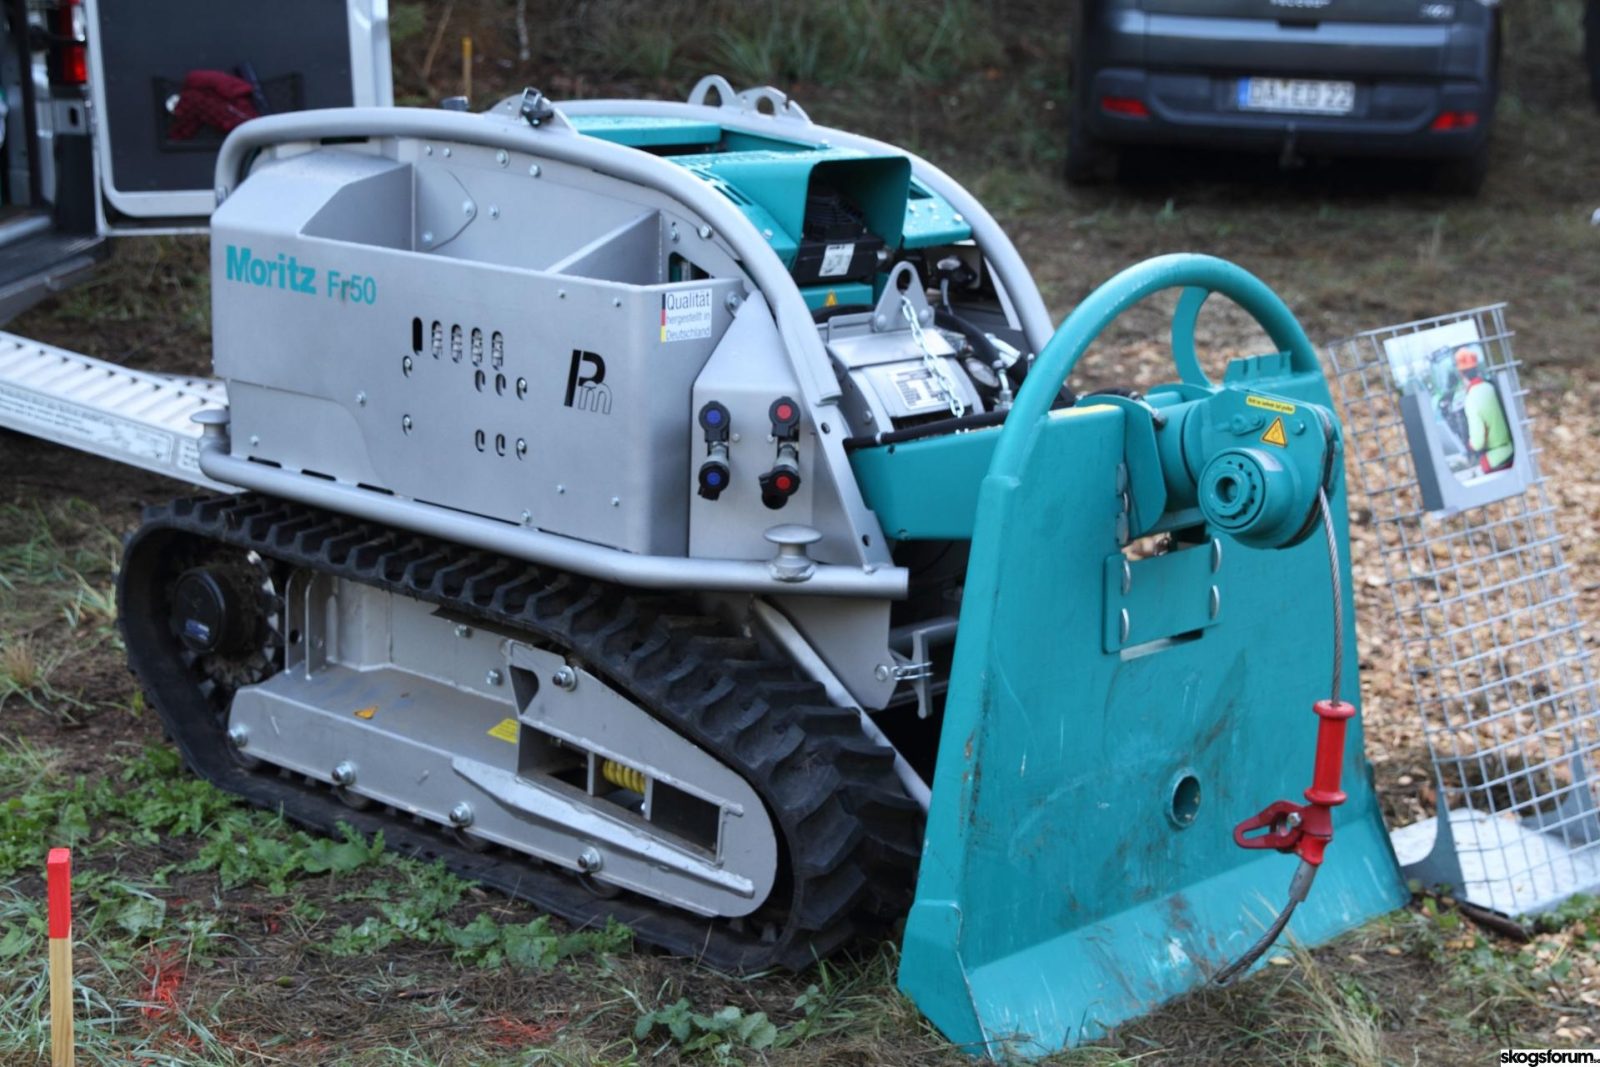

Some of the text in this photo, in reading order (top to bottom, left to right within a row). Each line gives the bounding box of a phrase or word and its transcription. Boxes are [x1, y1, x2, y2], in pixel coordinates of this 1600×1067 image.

[226, 245, 376, 305] Moritz Fr50
[667, 291, 710, 311] Qualität
